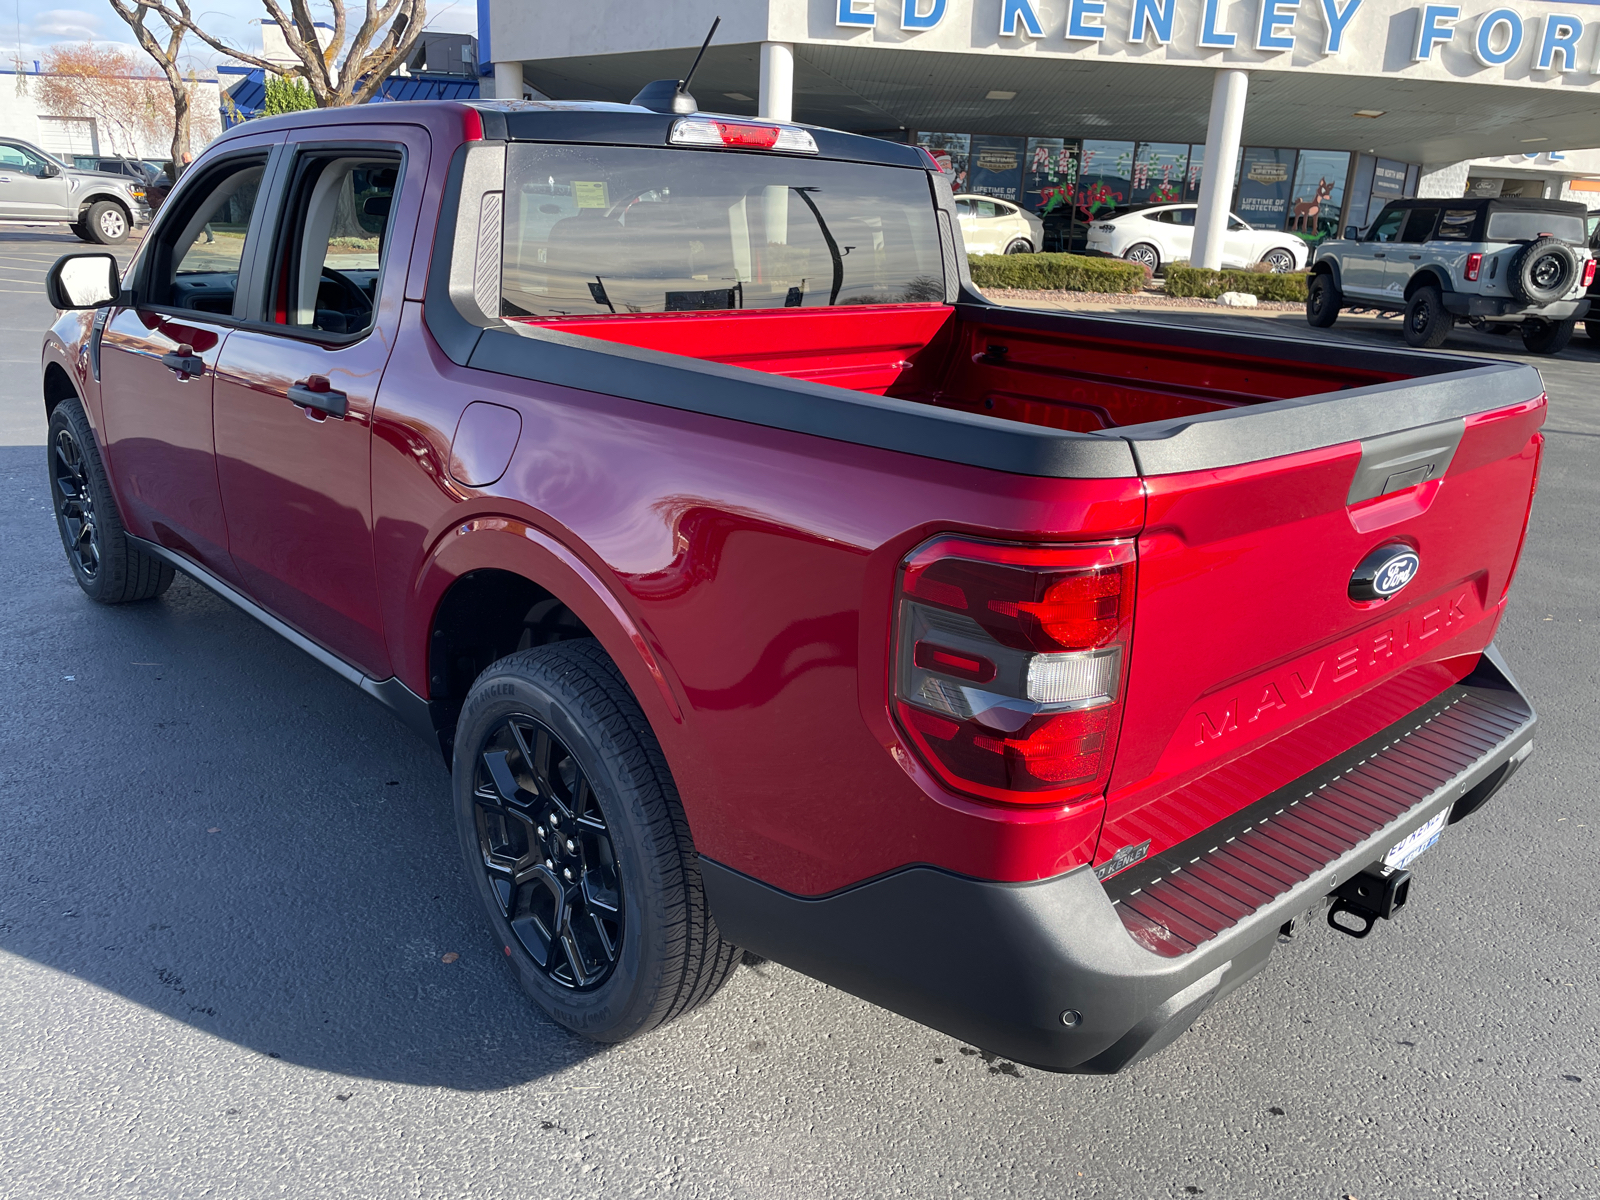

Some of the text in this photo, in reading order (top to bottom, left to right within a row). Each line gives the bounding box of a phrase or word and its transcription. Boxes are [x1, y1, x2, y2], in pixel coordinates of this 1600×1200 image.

[999, 0, 1364, 55] KENLEY
[1411, 3, 1600, 75] FOR
[1031, 147, 1096, 184] MERRY
[973, 186, 1004, 194] LIFETIME
[1241, 204, 1284, 212] PROTECTION
[1382, 559, 1413, 590] Ford
[1194, 593, 1466, 747] MAVERICK
[467, 683, 516, 716] WRANGLER
[1107, 843, 1150, 875] KENLEY
